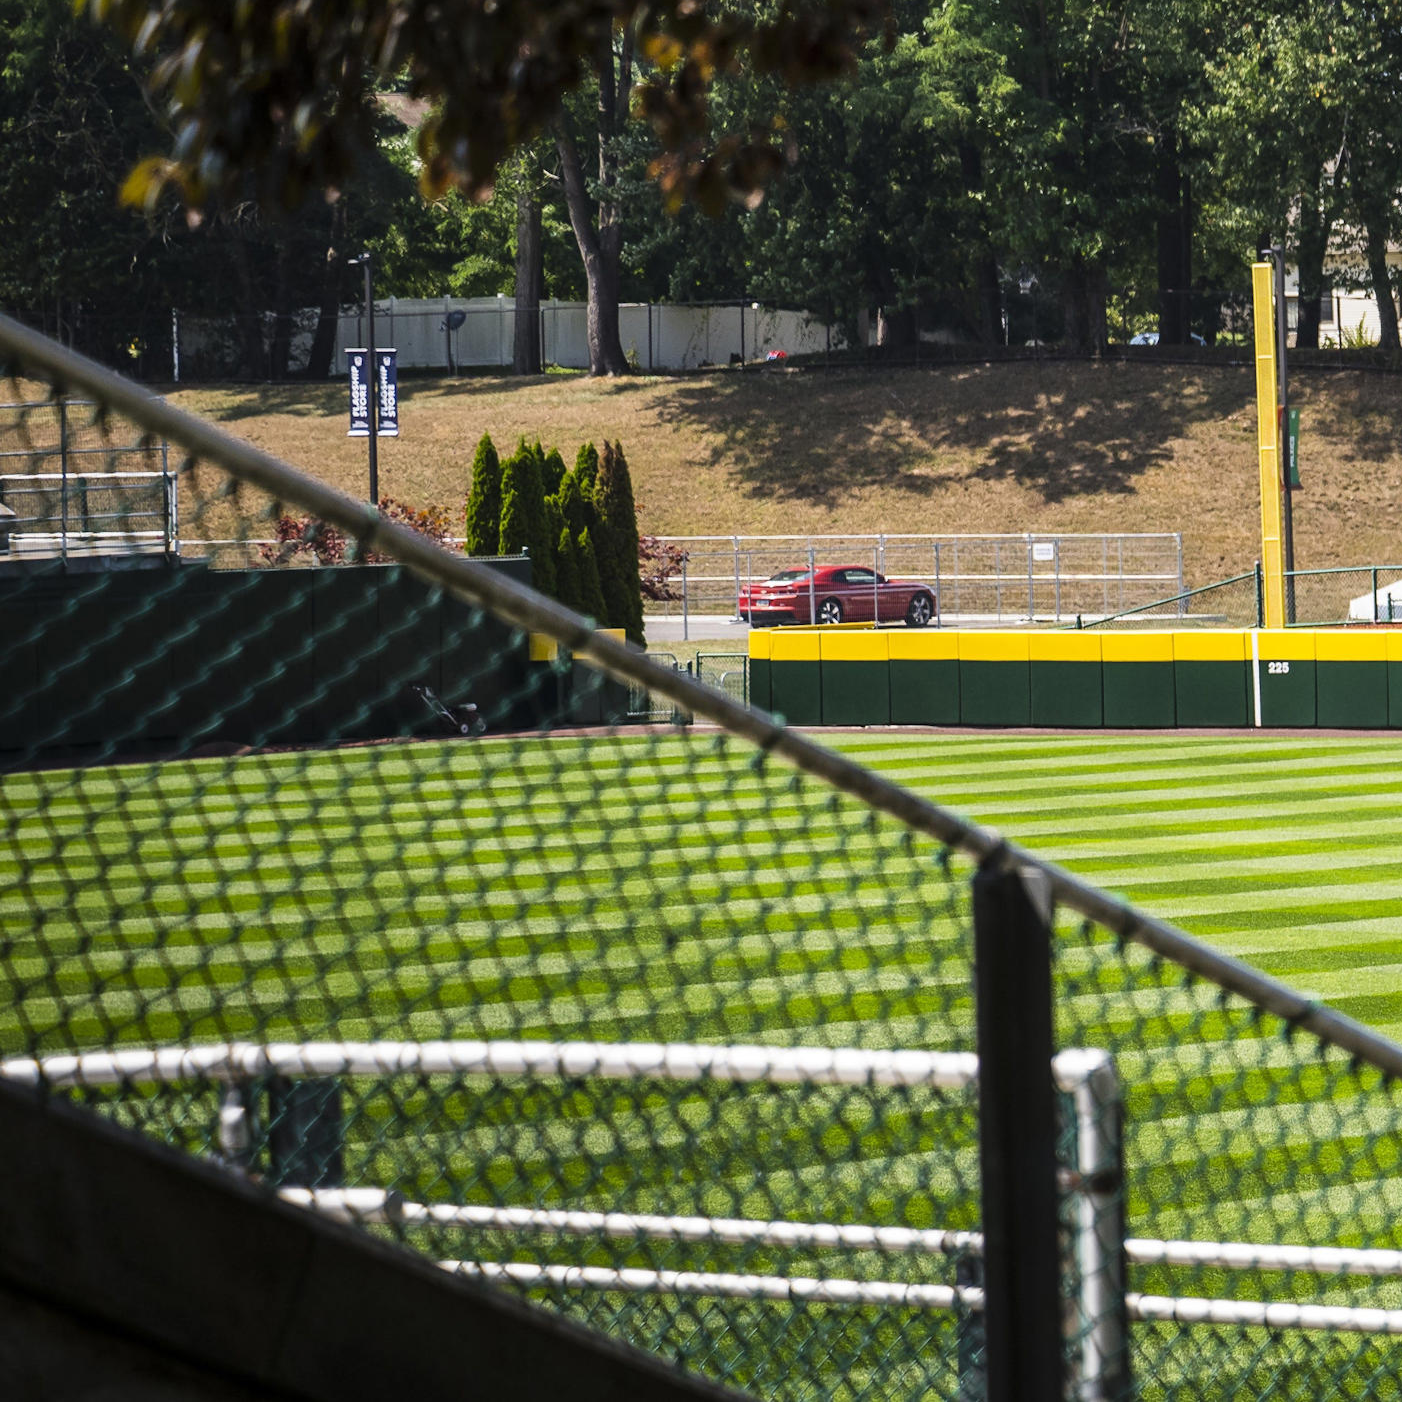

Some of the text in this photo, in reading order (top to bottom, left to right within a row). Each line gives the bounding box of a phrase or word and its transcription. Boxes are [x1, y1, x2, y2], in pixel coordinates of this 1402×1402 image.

[350, 365, 360, 417] FLAGSHIP
[360, 384, 368, 418] STORE
[388, 384, 396, 418] STORE
[1268, 661, 1290, 675] 225
